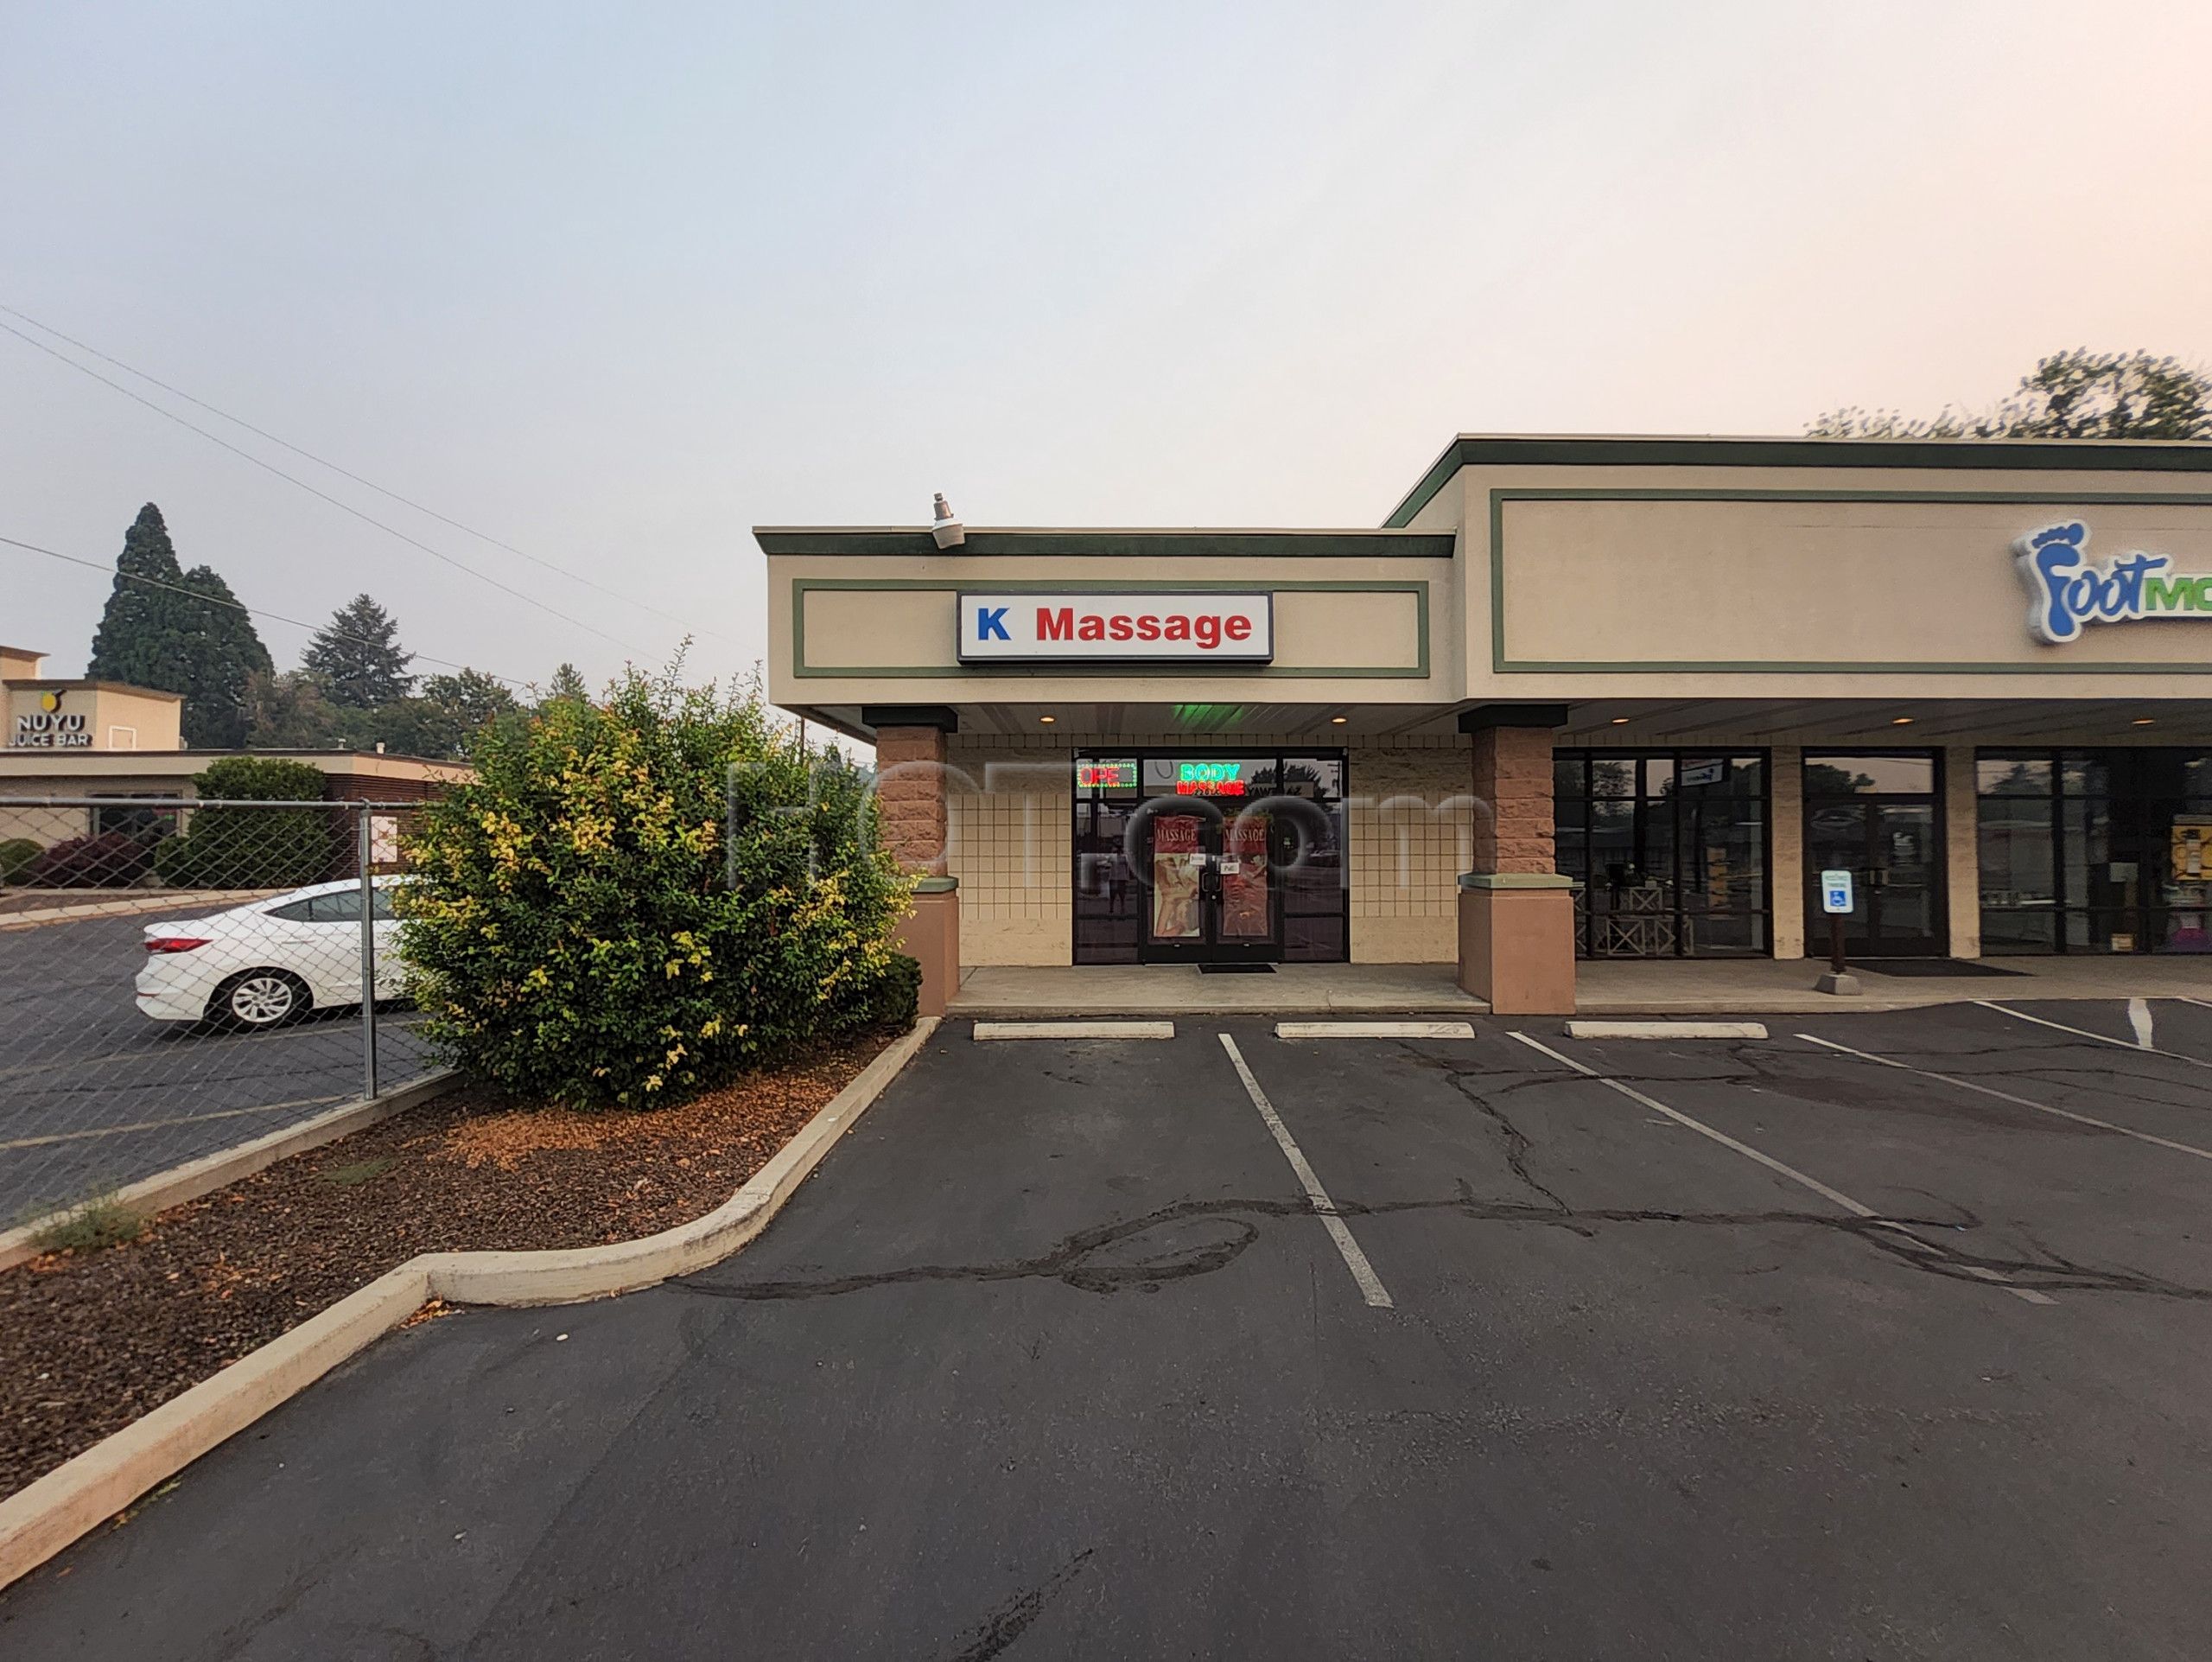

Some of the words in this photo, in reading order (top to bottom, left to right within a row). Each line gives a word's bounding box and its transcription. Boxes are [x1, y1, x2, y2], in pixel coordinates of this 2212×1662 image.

[977, 607, 1012, 641] K
[1036, 607, 1252, 650] Massage
[17, 714, 84, 732] NUYU
[8, 733, 53, 747] JUICE
[55, 734, 92, 747] BAR
[1179, 762, 1241, 781] BODY
[1176, 780, 1245, 795] MASSAGE
[1156, 828, 1197, 842] MASSAGE
[1224, 828, 1265, 842] MASSAGE
